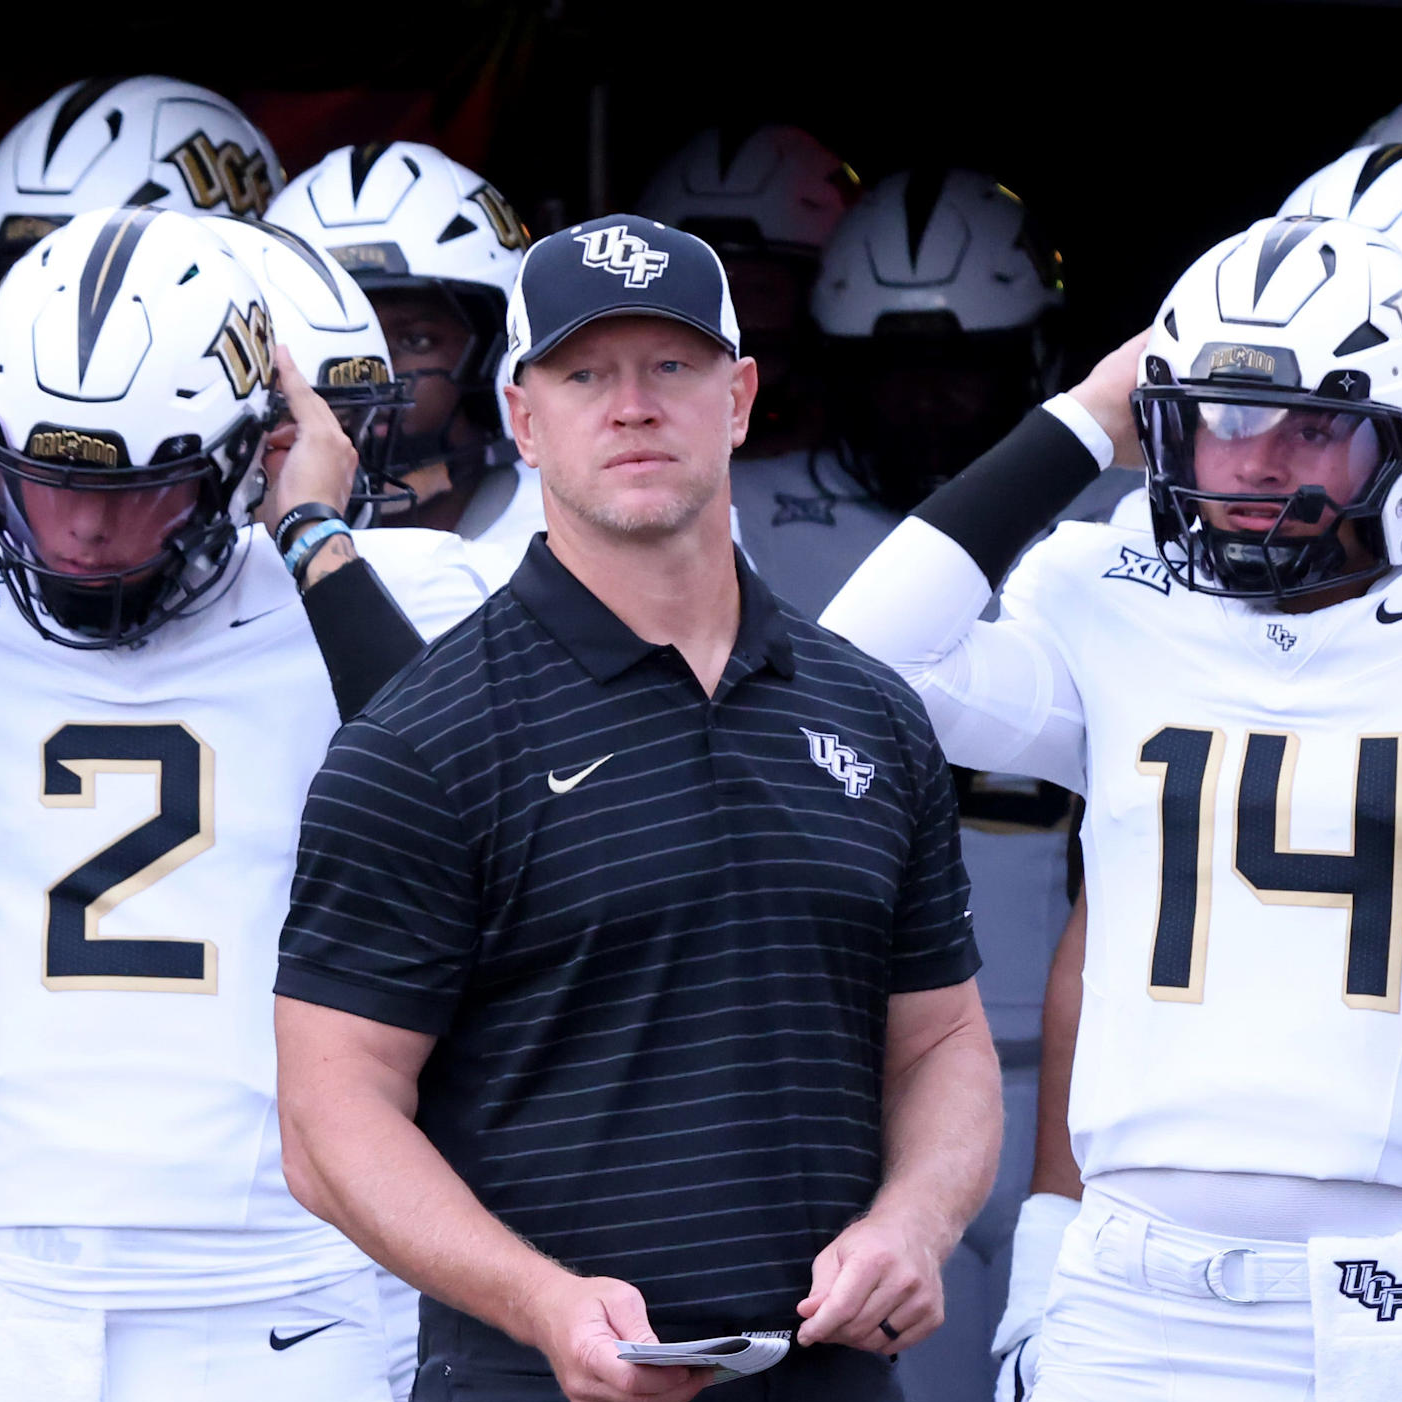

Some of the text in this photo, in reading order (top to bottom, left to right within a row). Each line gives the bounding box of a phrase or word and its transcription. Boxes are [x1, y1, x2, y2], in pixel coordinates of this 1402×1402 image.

[573, 226, 669, 288] UCF
[1210, 345, 1275, 375] ORLNDO
[31, 430, 117, 467] ORLNDO
[1267, 624, 1296, 651] UCF
[799, 727, 875, 798] UCF
[39, 720, 218, 996] 2
[741, 1330, 792, 1340] KNIGHTS
